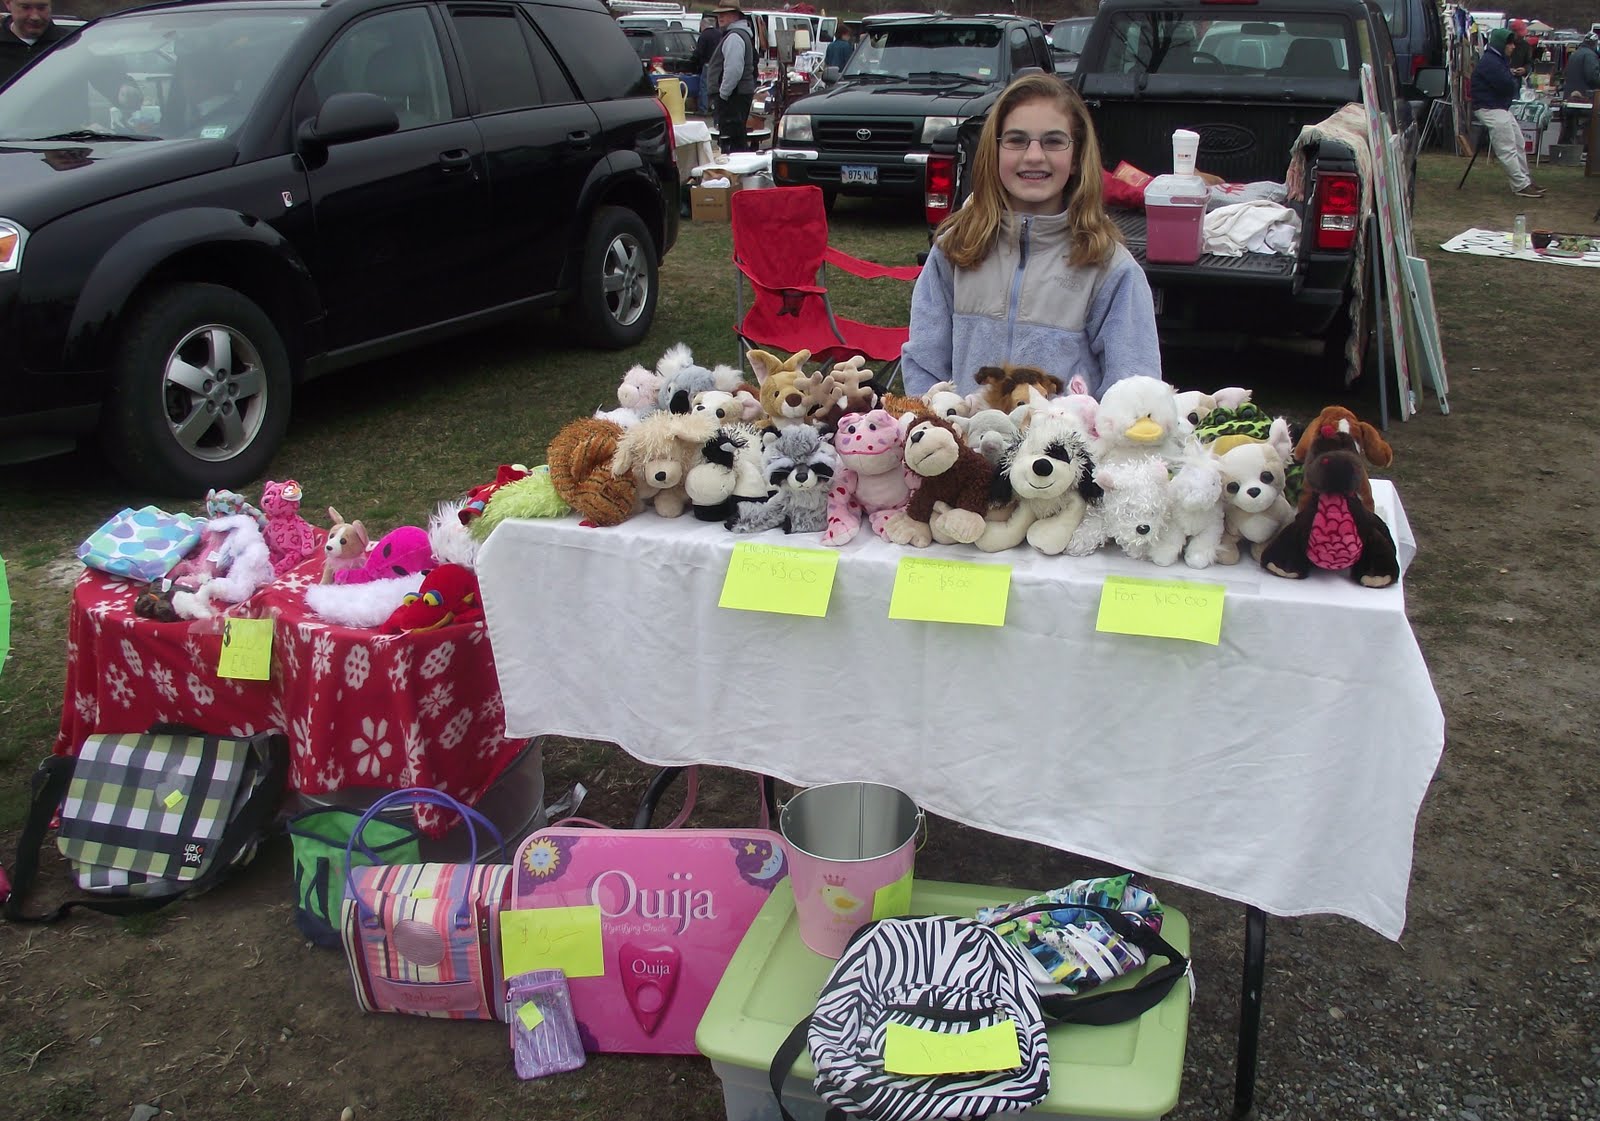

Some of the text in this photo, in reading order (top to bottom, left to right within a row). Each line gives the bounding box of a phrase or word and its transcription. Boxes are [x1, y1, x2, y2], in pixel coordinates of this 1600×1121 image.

[1113, 586, 1138, 602] For
[588, 869, 718, 936] Ouija
[631, 959, 671, 979] Ouija
